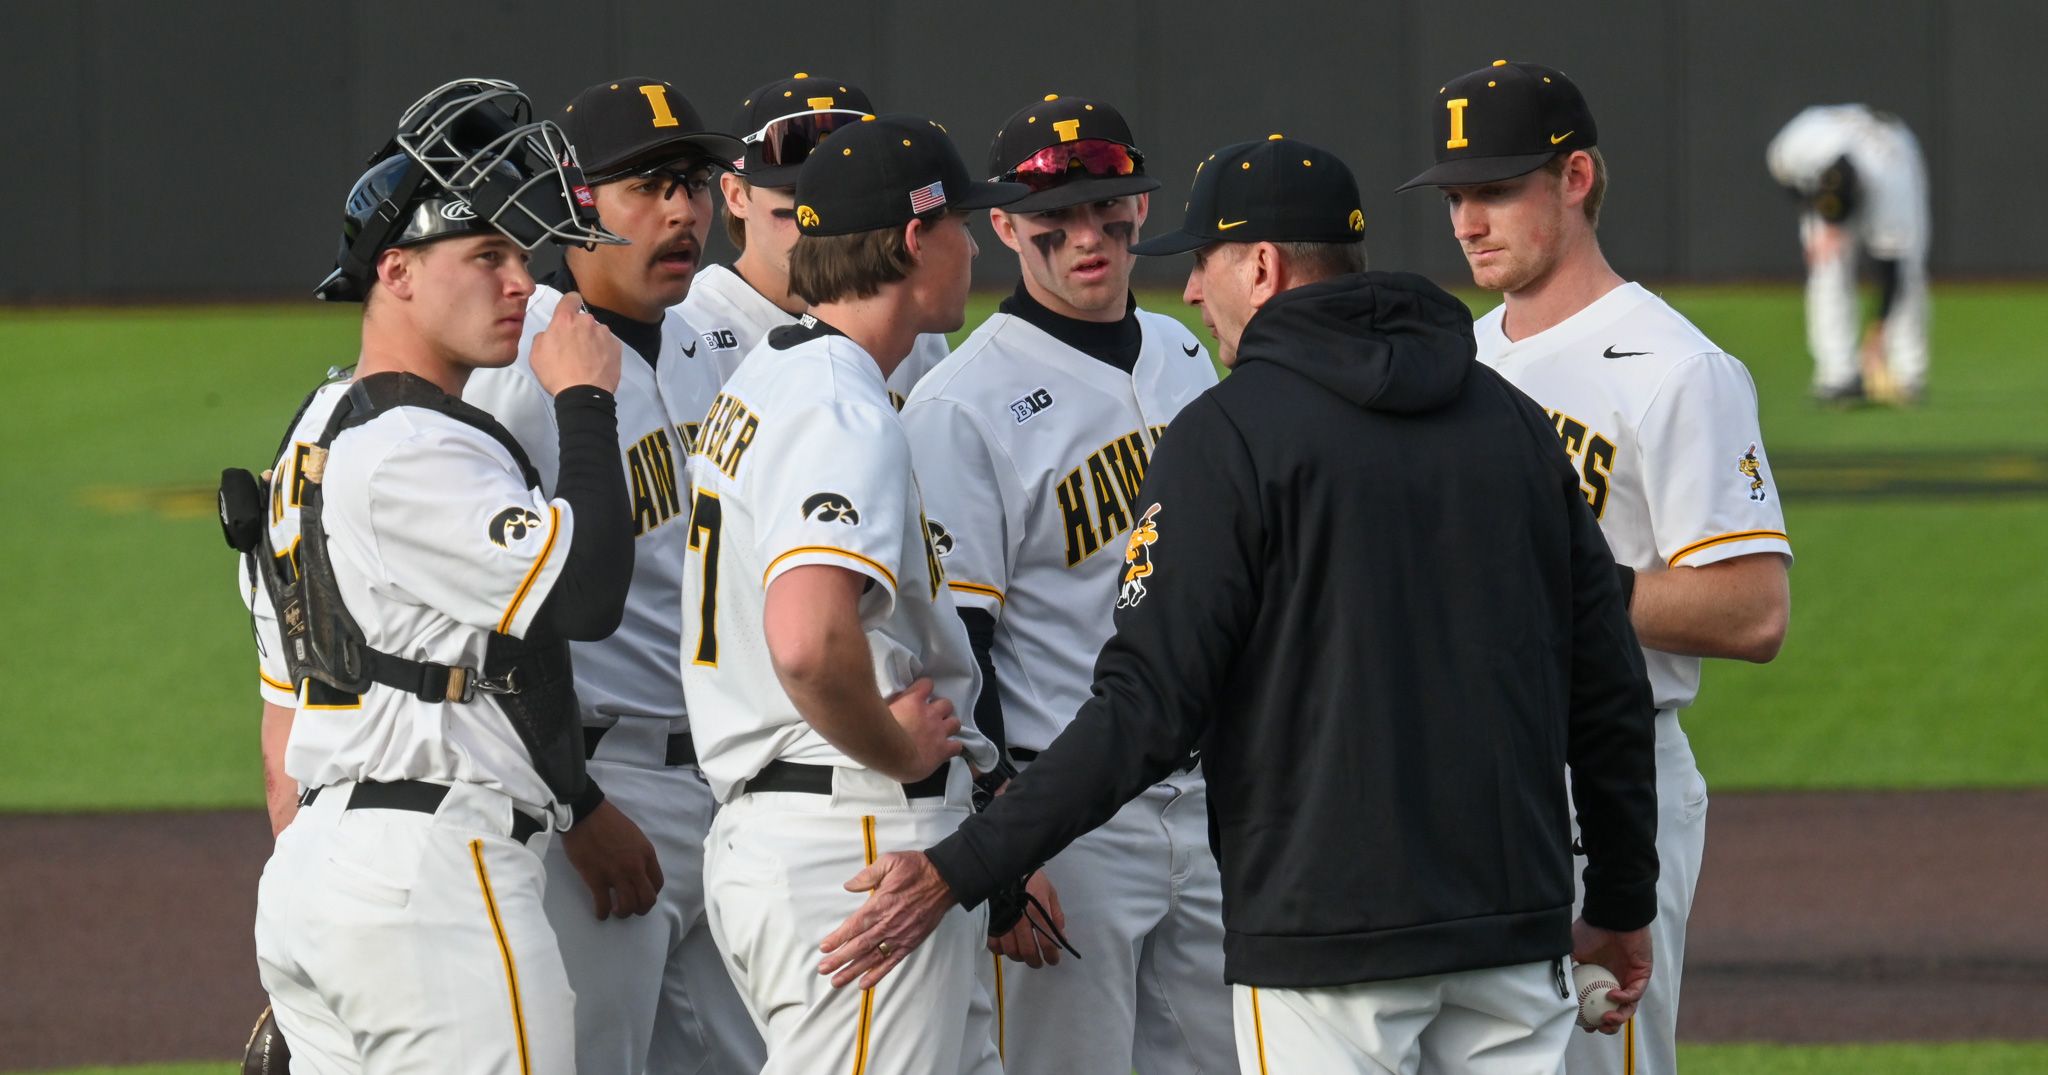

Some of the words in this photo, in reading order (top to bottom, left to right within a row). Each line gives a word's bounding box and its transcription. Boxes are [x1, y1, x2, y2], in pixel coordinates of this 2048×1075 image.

[639, 85, 679, 128] I
[1447, 98, 1468, 149] I
[688, 485, 722, 669] 7
